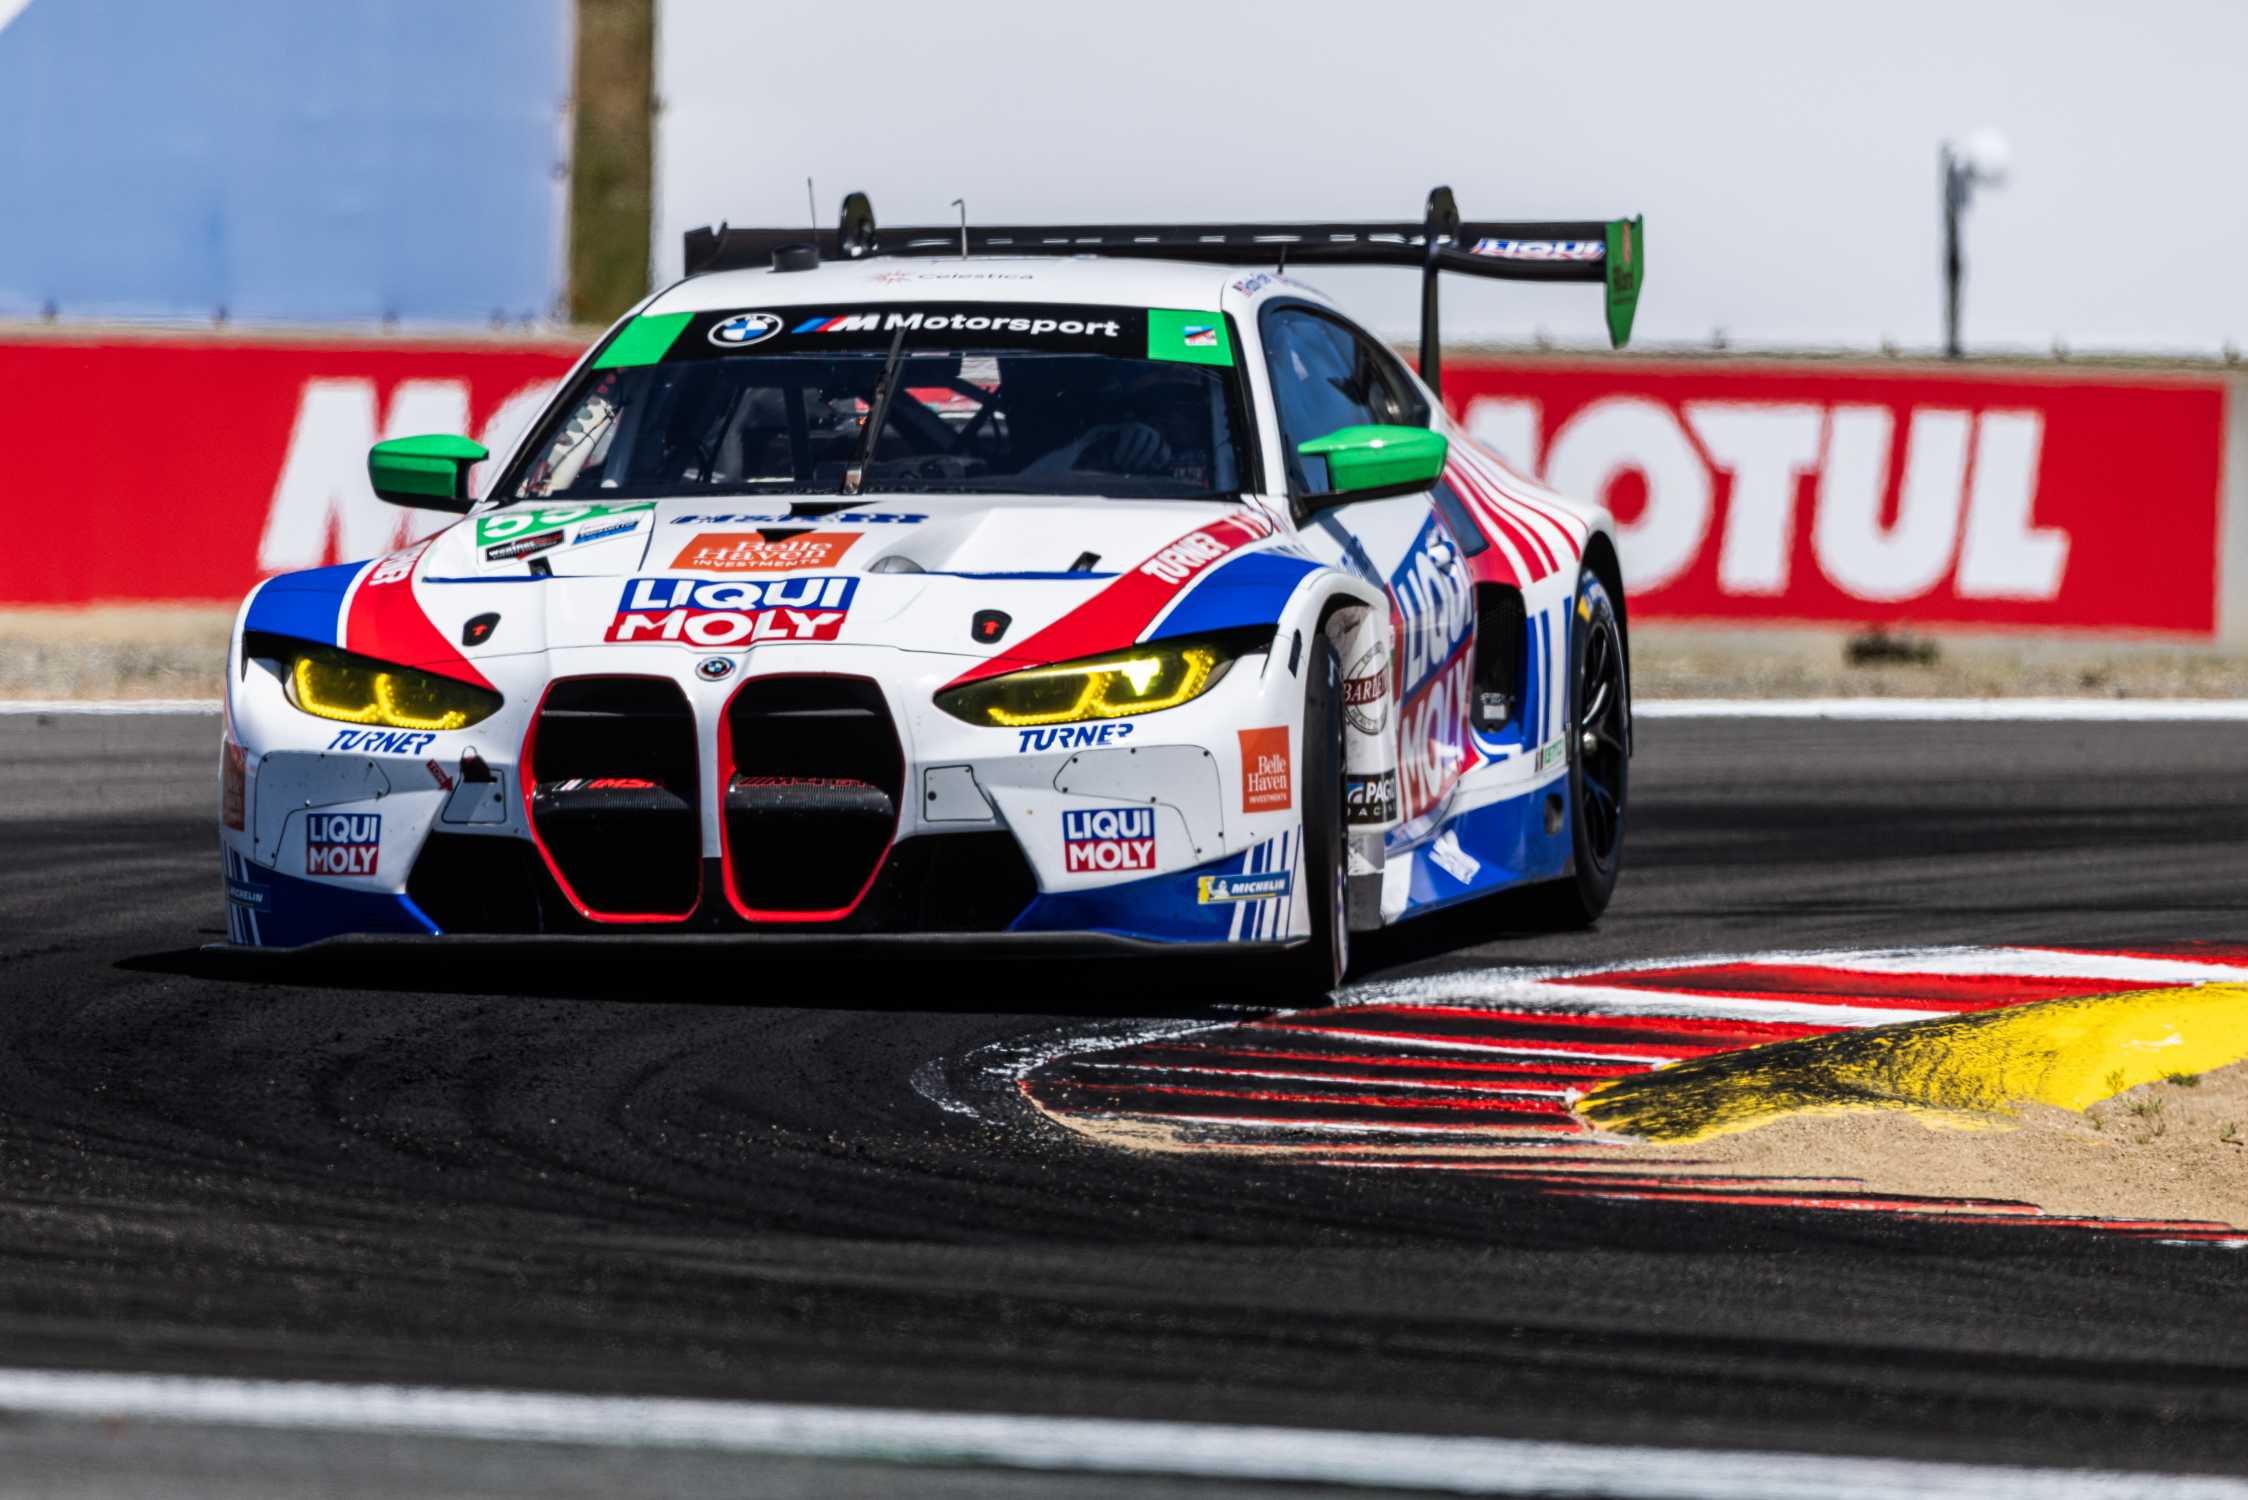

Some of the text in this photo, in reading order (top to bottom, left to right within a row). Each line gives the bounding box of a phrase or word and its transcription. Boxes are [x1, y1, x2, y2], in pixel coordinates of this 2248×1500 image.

[884, 314, 1121, 337] Motorsport
[693, 548, 827, 562] Haven
[734, 541, 833, 552] Belle
[1139, 531, 1231, 585] TURNER
[693, 558, 821, 568] INVESTMENTS
[628, 578, 848, 611] LIQUI
[616, 608, 844, 645] MOLY
[1398, 550, 1474, 693] LIQUI
[1258, 754, 1287, 775] Belle
[1248, 771, 1288, 793] Haven
[309, 815, 377, 844] LIQUI
[1067, 810, 1151, 840] LIQUI
[309, 845, 378, 874] MOLY
[1069, 841, 1153, 870] MOLY
[1231, 878, 1286, 895] MICHELIN
